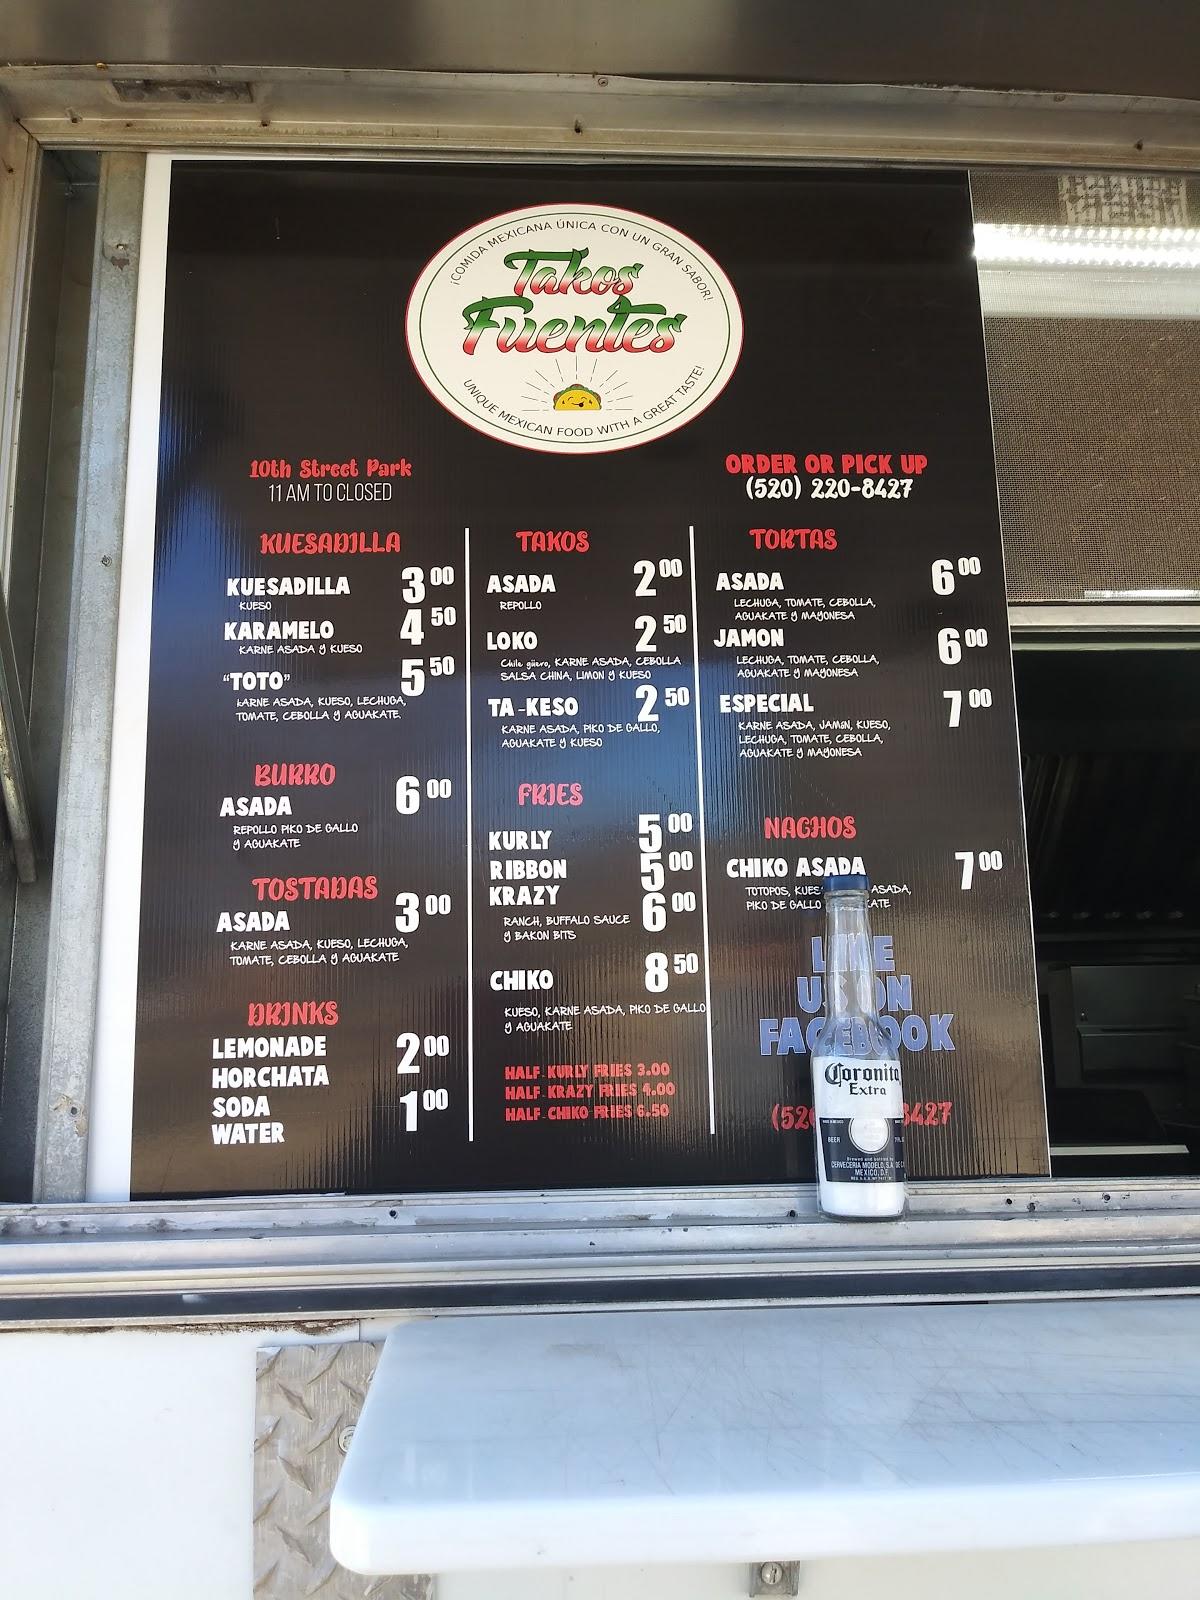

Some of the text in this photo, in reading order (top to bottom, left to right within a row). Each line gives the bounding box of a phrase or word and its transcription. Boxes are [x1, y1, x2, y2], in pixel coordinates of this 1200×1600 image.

[488, 219, 684, 265] MEXICANA ÚNICA CON UN GRAN
[504, 247, 644, 297] Takos
[462, 294, 687, 356] Fuentes
[463, 378, 630, 437] UNIQUE MEXICAN FOOD WITH
[250, 459, 411, 478] 10th Street Park
[726, 454, 927, 474] ORDER OR PICK UP
[269, 483, 391, 501] 11 AM TO CLOSED
[747, 475, 913, 499] (520) 220-8427
[261, 532, 400, 554] KUESADILLA
[516, 531, 589, 552] TAKOS
[749, 529, 837, 550] TORTAS
[227, 577, 350, 596] KUESADILLA
[487, 575, 555, 593] ASADA
[716, 573, 784, 590] ASADA
[240, 602, 271, 610] KUESO
[500, 601, 541, 610] REPOLLO
[735, 598, 875, 608] LECHUGA, TOMATE, CEBOLLA,
[735, 611, 855, 621] AGUAKATE MAYONESA
[225, 621, 334, 640] KARAMELO
[714, 629, 783, 647] JAMON
[239, 644, 362, 654] KARNE ASADA KUESO
[487, 632, 537, 650] LOKO
[555, 657, 681, 667] KARNE ASADA, CEBOLLA
[737, 655, 879, 665] LECHUGA, TOMATE, CEBOLLA,
[501, 670, 651, 681] SALSA CHINA, LIMON KUESO
[737, 668, 858, 678] AGUAKATE MAYONESA
[273, 696, 406, 707] ASADA, KUESO, LECHUGA,
[720, 694, 814, 713] ESPECIAL
[236, 711, 329, 722] TOMATE, CEBOLLA
[738, 720, 890, 731] KARNE ASADA, KUESO,
[502, 723, 660, 734] KARNE ASADA, PIKO DE GALLO,
[502, 738, 602, 748] AGUAKATE KUESO
[739, 734, 883, 745] LECHUGA, TOMATE, CEBOLLA,
[740, 747, 862, 758] AGUAKATE MAYONESA
[255, 763, 335, 786] BURRO
[519, 783, 583, 805] FRIES
[220, 796, 292, 816] ASADA
[233, 823, 358, 835] REPOLLO PIKO DE GALLO
[765, 816, 856, 838] NACHOS
[244, 839, 300, 848] AGUAKATE
[489, 831, 552, 850] KURLY
[490, 859, 566, 880] RIBBON
[727, 857, 866, 878] CHIKO ASADA
[252, 876, 377, 901] TOSTADAS
[490, 885, 559, 906] KRAZY
[745, 885, 911, 897] TOTOPOS, ASADA,
[747, 900, 821, 910] PIKO DE GALLO
[216, 911, 290, 932] ASADA
[504, 915, 630, 927] RANCH, BUFFALO SAUCE
[515, 930, 576, 940] BAKON BITS
[231, 938, 408, 951] KARNE ASADA, KUESO, LECHUGA,
[230, 953, 399, 966] TOMATE, CEBOLLA AGUAKATE
[490, 970, 553, 990] CHIKO
[248, 1001, 338, 1026] DRINKS
[505, 1003, 705, 1018] KUESO, KARNE ASADA, PIKO DE GALLO
[516, 1021, 573, 1031] AGUAKATE
[213, 1036, 326, 1059] LEMONADE
[212, 1065, 329, 1088] HORCHATA
[505, 1063, 669, 1079] HALF KURLY FRIES 3.00
[506, 1086, 540, 1099] HALF
[548, 1083, 593, 1098] KRAZY
[599, 1083, 637, 1097] FRIES
[850, 1083, 886, 1095] Extra
[212, 1096, 270, 1117] SODA
[506, 1104, 669, 1121] HALF CHIKO FRIES 6.50
[212, 1122, 285, 1144] WATER
